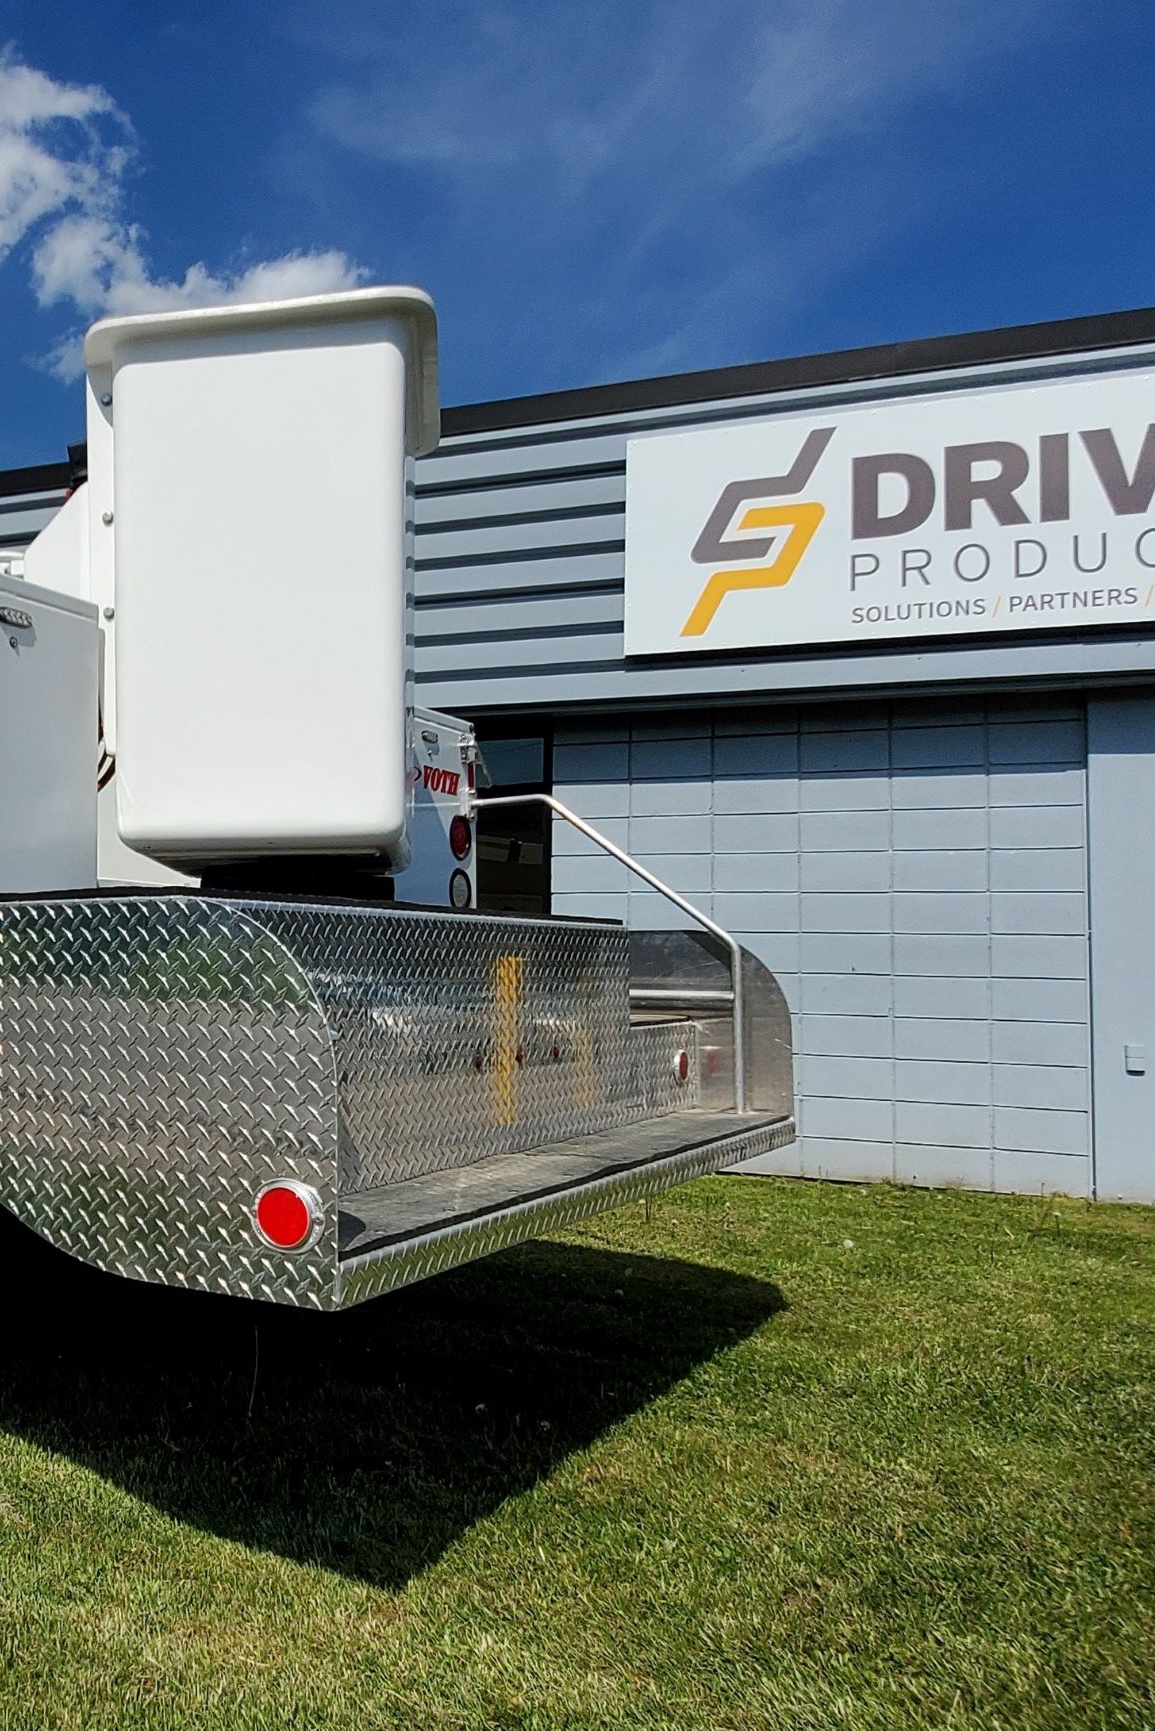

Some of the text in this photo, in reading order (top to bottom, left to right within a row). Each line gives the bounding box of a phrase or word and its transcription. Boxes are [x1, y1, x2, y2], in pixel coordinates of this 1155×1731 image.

[852, 598, 986, 623] SOLUTIONS
[1009, 587, 1138, 613] PARTNERS
[423, 764, 461, 796] VOTH
